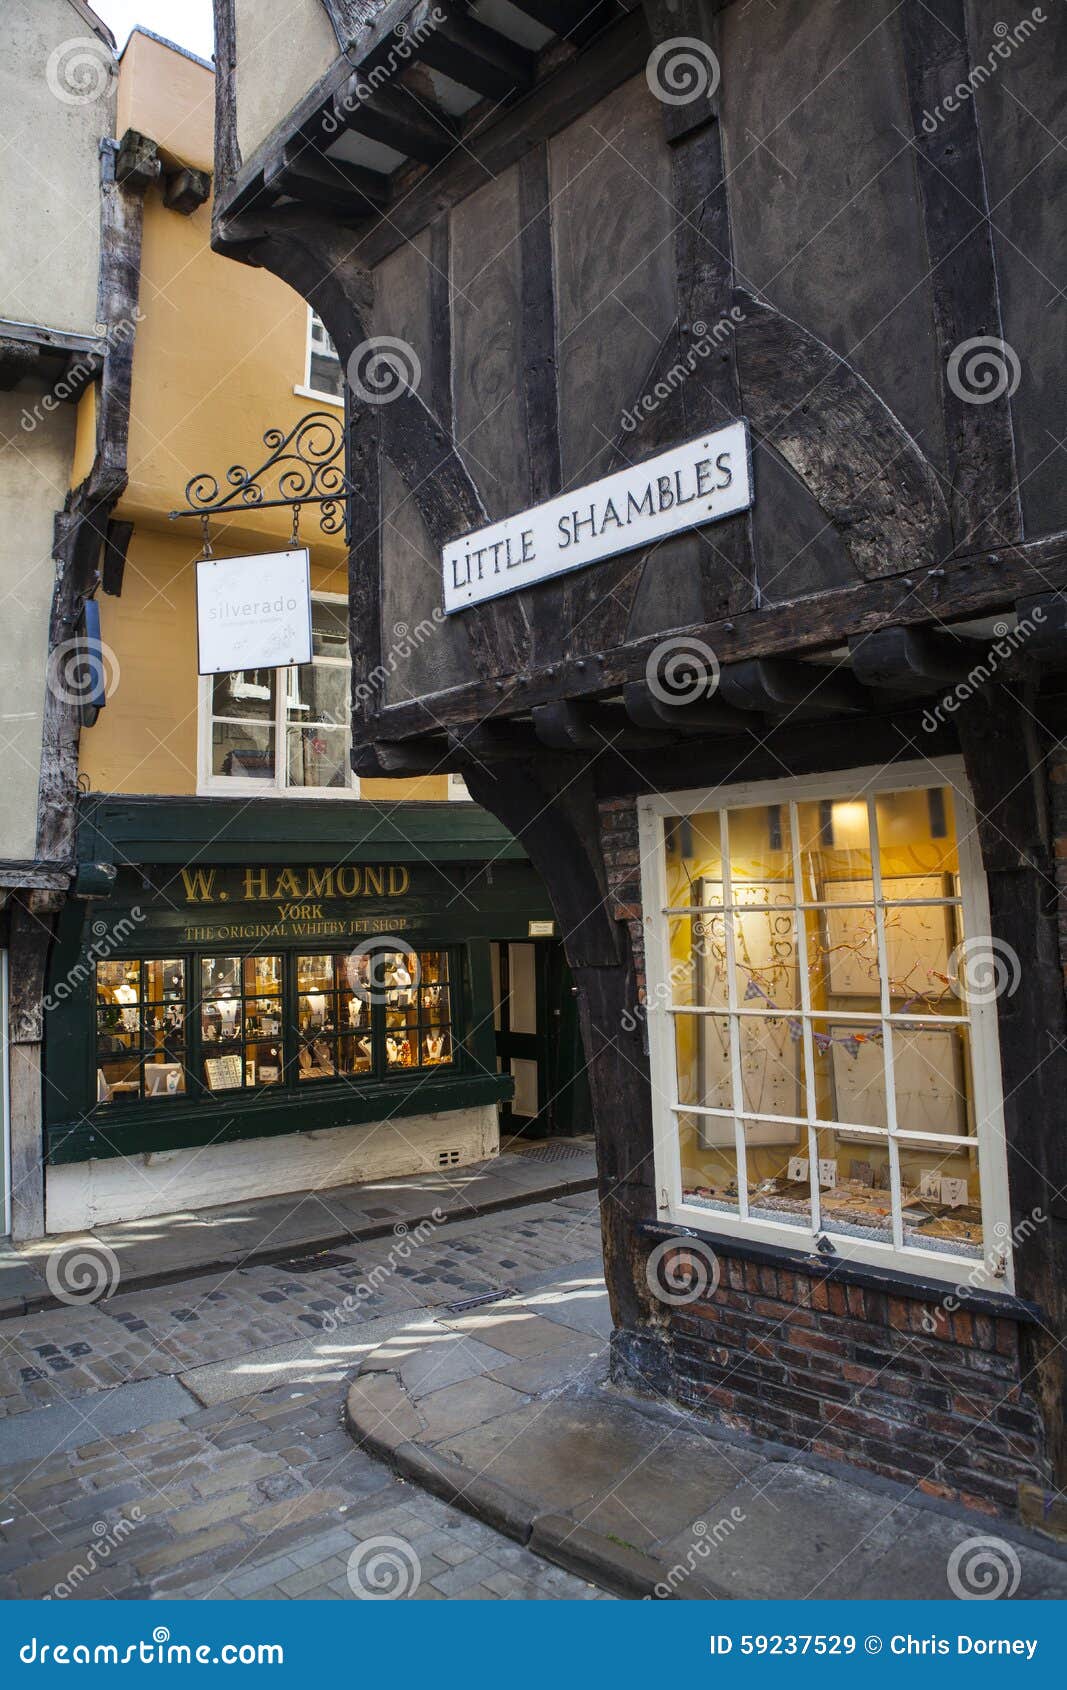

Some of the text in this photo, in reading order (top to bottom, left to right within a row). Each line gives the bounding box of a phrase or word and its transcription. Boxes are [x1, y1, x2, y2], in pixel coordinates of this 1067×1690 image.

[452, 452, 733, 589] LITTLE SHAMBLES
[208, 595, 297, 620] silverado
[181, 866, 410, 902] W. HAMOND
[277, 903, 324, 921] YORK
[184, 918, 408, 941] THE ORIGINAL WHITBY JET SHOP
